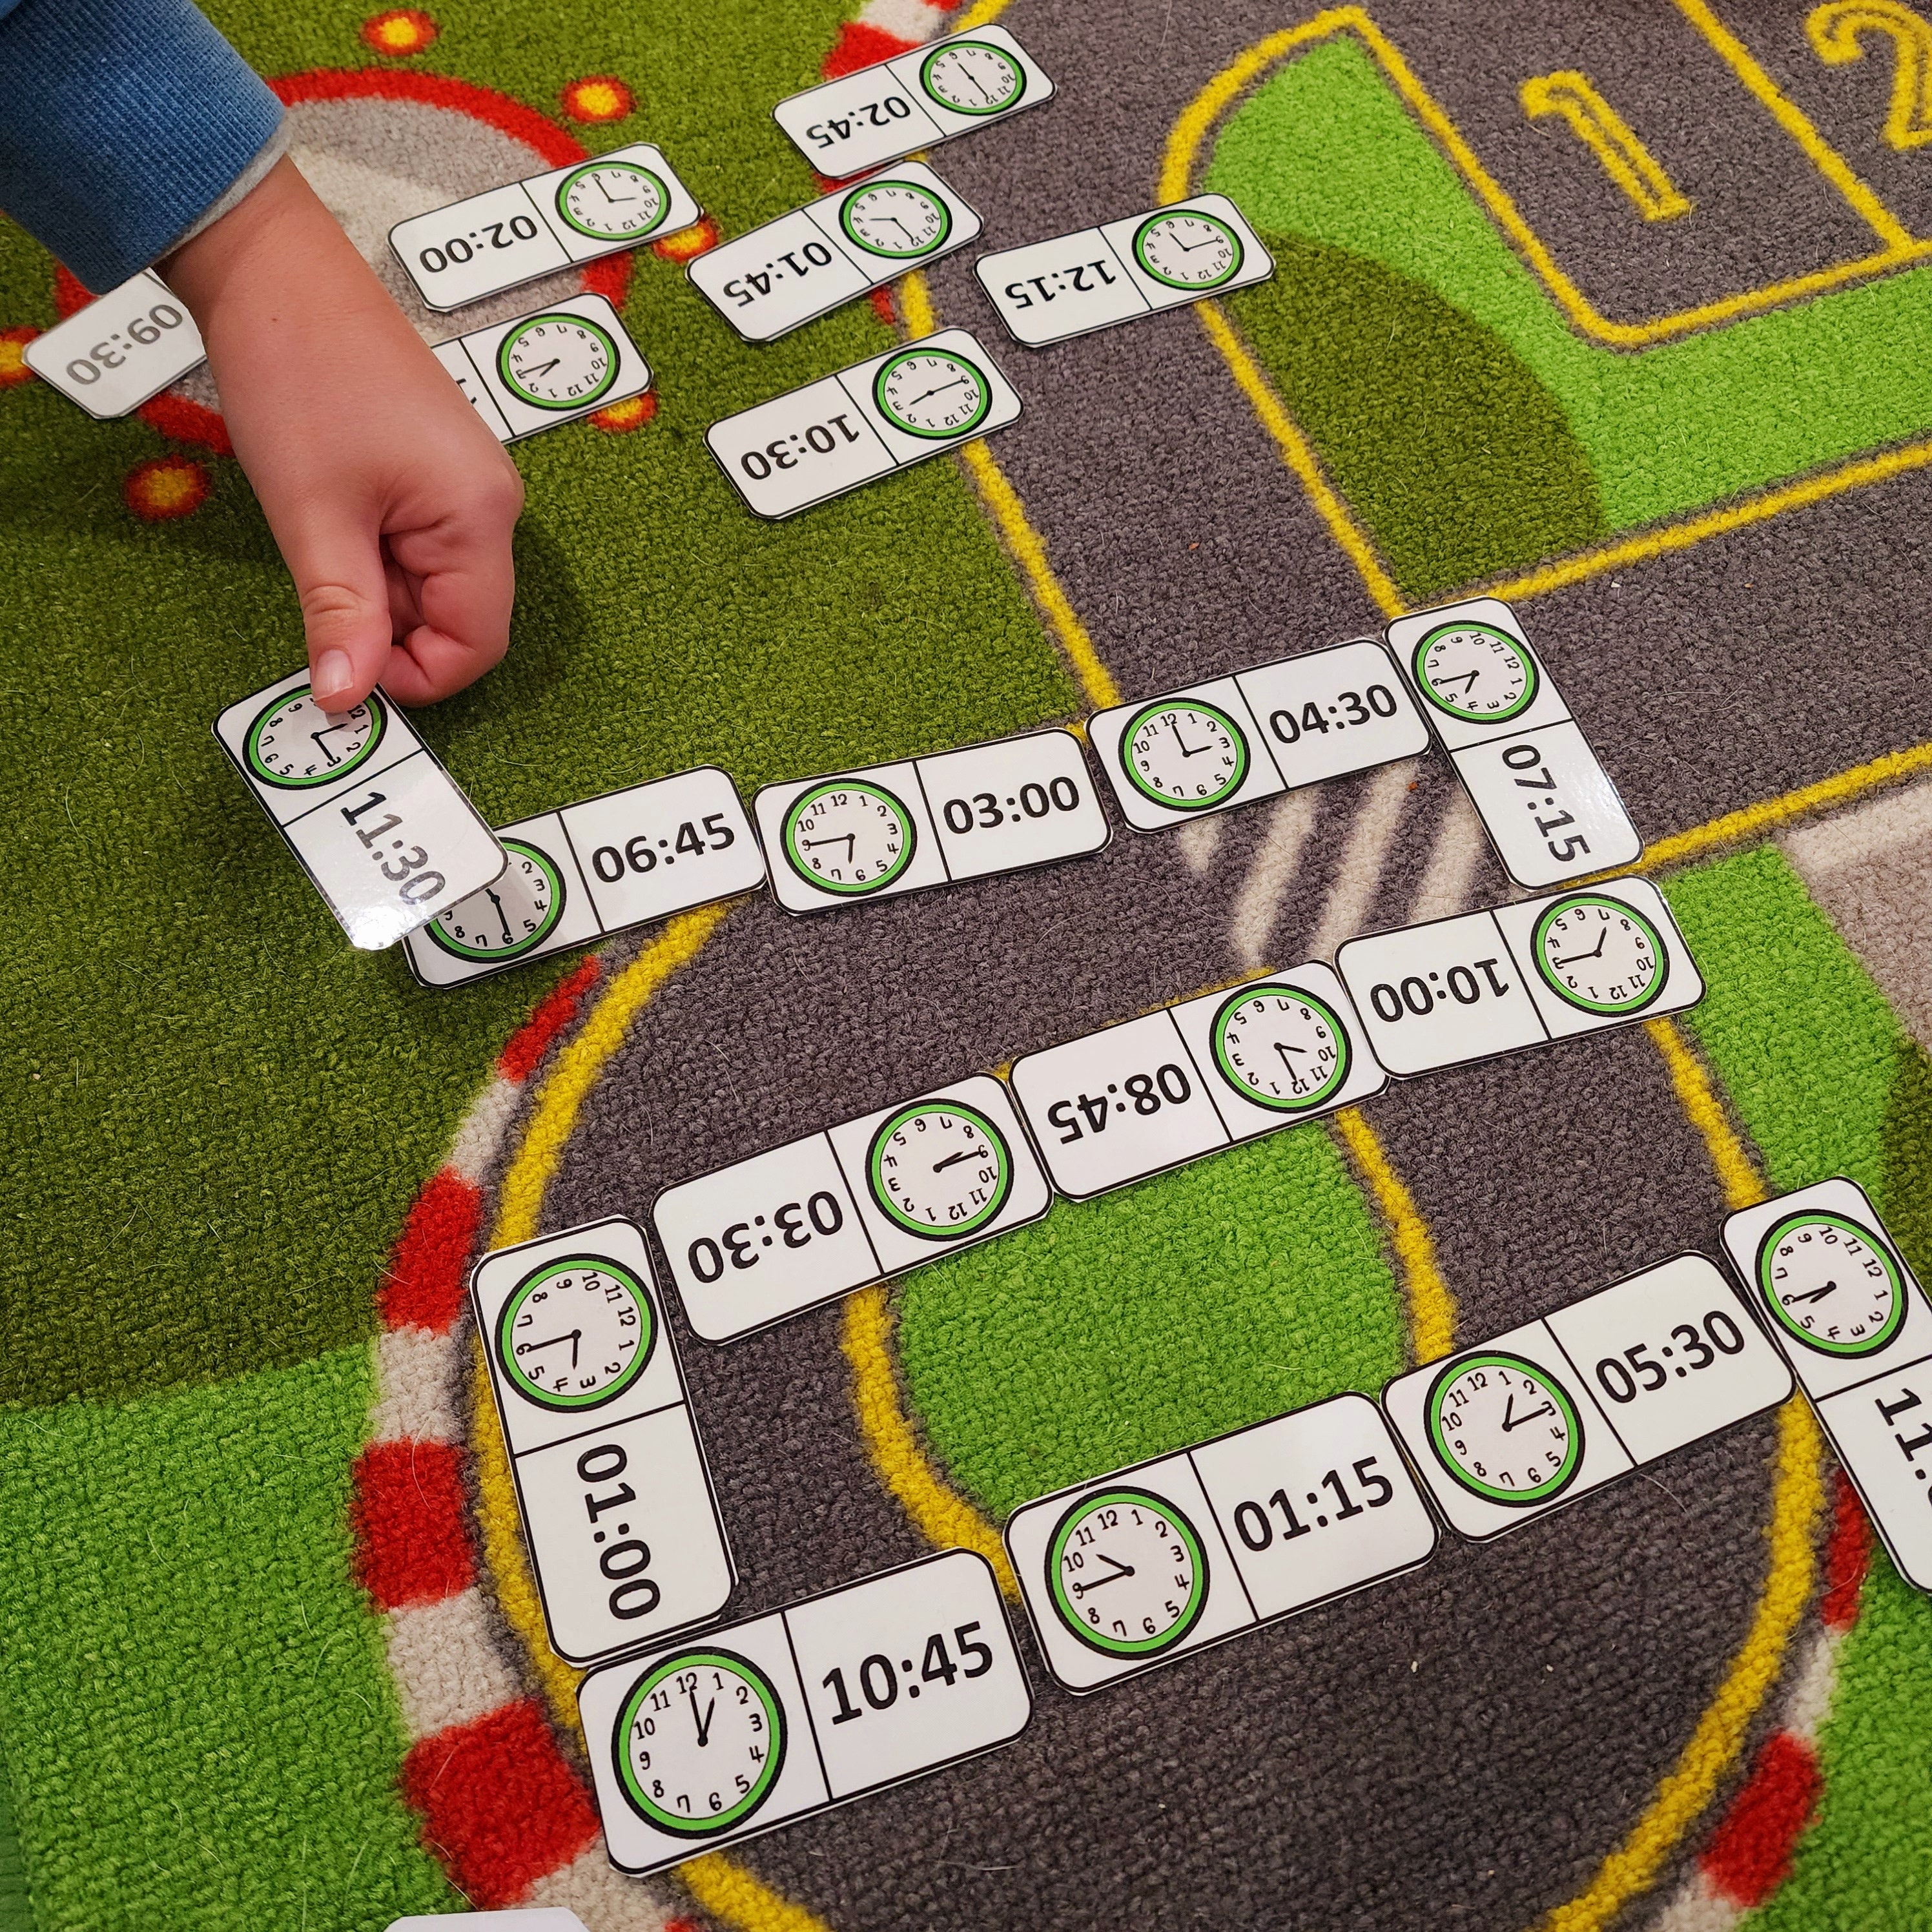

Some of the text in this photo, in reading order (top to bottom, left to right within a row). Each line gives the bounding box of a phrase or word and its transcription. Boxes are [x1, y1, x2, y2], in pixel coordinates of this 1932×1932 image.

[935, 59, 945, 68] 5
[1002, 74, 1016, 83] 10
[1805, 0, 1932, 151] 2
[998, 86, 1011, 95] 11
[807, 97, 910, 149] 02:45
[1521, 69, 1692, 221] 1
[644, 198, 659, 208] 10
[638, 211, 651, 220] 11
[925, 213, 940, 223] 10
[622, 220, 637, 230] 12
[922, 226, 936, 236] 11
[1149, 228, 1160, 237] 5
[420, 216, 537, 272] 02:00
[1218, 248, 1232, 258] 10
[1163, 267, 1171, 275] 2
[1213, 261, 1226, 271] 11
[723, 243, 832, 307] 01:45
[1198, 269, 1211, 279] 12
[1005, 260, 1116, 309] 12:15
[577, 331, 586, 339] 8
[67, 305, 183, 384] 09:30
[518, 337, 529, 347] 5
[591, 358, 608, 369] 10
[947, 364, 956, 372] 8
[584, 373, 599, 385] 11
[891, 371, 902, 380] 5
[529, 383, 539, 393] 2
[567, 384, 583, 396] 12
[964, 389, 979, 400] 10
[958, 404, 974, 415] 11
[907, 413, 916, 423] 2
[943, 414, 960, 426] 12
[741, 414, 859, 480] 10:30
[1489, 641, 1505, 653] 11
[1503, 656, 1520, 669] 12
[288, 703, 302, 712] 9
[347, 704, 365, 719] 12
[1467, 701, 1478, 710] 4
[1486, 701, 1499, 709] 3
[1187, 713, 1197, 724] 1
[1270, 684, 1397, 743] 04:30
[269, 717, 283, 727] 8
[1207, 721, 1217, 732] 2
[354, 724, 369, 734] 1
[1143, 724, 1159, 737] 11
[346, 742, 361, 752] 2
[1133, 741, 1149, 754] 10
[1218, 737, 1230, 748] 3
[280, 764, 294, 775] 5
[1153, 777, 1163, 788] 8
[1214, 774, 1226, 785] 5
[830, 794, 847, 807] 12
[859, 796, 868, 807] 1
[943, 777, 1079, 834] 03:00
[1502, 745, 1590, 861] 07:15
[810, 803, 827, 816] 11
[877, 805, 887, 817] 2
[797, 819, 814, 832] 10
[887, 823, 898, 835] 3
[340, 792, 446, 905] 11:30
[593, 813, 734, 882] 06:45
[522, 861, 533, 874] 2
[812, 858, 821, 869] 8
[533, 879, 545, 891] 3
[534, 899, 548, 912] 4
[523, 919, 536, 932] 5
[1555, 918, 1568, 930] 5
[1620, 919, 1630, 931] 8
[455, 926, 465, 938] 8
[475, 934, 488, 947] 7
[1635, 937, 1645, 949] 9
[1636, 956, 1654, 971] 10
[1567, 976, 1577, 989] 2
[1627, 974, 1645, 989] 11
[1370, 958, 1509, 1022] 10:00
[1587, 987, 1599, 998] 1
[1609, 985, 1627, 1000] 12
[1253, 1000, 1264, 1012] 6
[1300, 1008, 1311, 1020] 8
[1226, 1032, 1240, 1044] 4
[1316, 1026, 1326, 1038] 9
[1232, 1053, 1244, 1066] 3
[1318, 1046, 1336, 1062] 10
[1248, 1072, 1259, 1085] 2
[1310, 1065, 1328, 1081] 11
[1048, 1064, 1191, 1144] 08:45
[893, 1131, 906, 1146] 5
[963, 1125, 974, 1139] 8
[883, 1155, 898, 1167] 4
[979, 1166, 997, 1183] 10
[888, 1177, 901, 1191] 3
[969, 1188, 987, 1205] 11
[903, 1198, 914, 1212] 2
[948, 1202, 967, 1220] 12
[688, 1191, 843, 1283] 03:30
[1818, 1226, 1838, 1244] 10
[1780, 1246, 1794, 1257] 8
[1844, 1238, 1862, 1256] 11
[1862, 1259, 1882, 1277] 12
[582, 1272, 601, 1291] 10
[532, 1291, 548, 1303] 8
[604, 1284, 622, 1303] 11
[1874, 1290, 1888, 1300] 1
[617, 1307, 636, 1326] 12
[1800, 1315, 1814, 1329] 5
[1869, 1311, 1884, 1322] 2
[1851, 1324, 1865, 1337] 3
[619, 1340, 634, 1351] 1
[1596, 1311, 1744, 1403] 05:30
[604, 1362, 621, 1374] 2
[553, 1377, 568, 1392] 4
[580, 1375, 596, 1388] 3
[1467, 1372, 1488, 1391] 12
[1499, 1371, 1511, 1386] 1
[1523, 1379, 1537, 1395] 2
[1449, 1389, 1470, 1408] 11
[1442, 1412, 1462, 1431] 10
[1455, 1440, 1467, 1455] 9
[1875, 1388, 1932, 1507] 11:
[1545, 1452, 1561, 1467] 5
[1528, 1467, 1541, 1483] 6
[1234, 1456, 1393, 1551] 01:15
[1098, 1510, 1118, 1530] 12
[1131, 1509, 1143, 1525] 1
[577, 1444, 660, 1619] 01:00
[1076, 1526, 1095, 1546] 11
[1155, 1521, 1167, 1538] 2
[1170, 1545, 1184, 1562] 3
[1175, 1574, 1189, 1590] 4
[1087, 1607, 1100, 1624] 8
[1165, 1600, 1180, 1618] 5
[823, 1621, 992, 1725] 10:45
[650, 1690, 671, 1711] 11
[736, 1686, 749, 1705] 2
[632, 1718, 655, 1740] 10
[749, 1713, 763, 1732] 3
[749, 1745, 765, 1763] 4
[652, 1780, 664, 1798] 8
[735, 1774, 750, 1794] 5
[709, 1793, 722, 1811] 6
